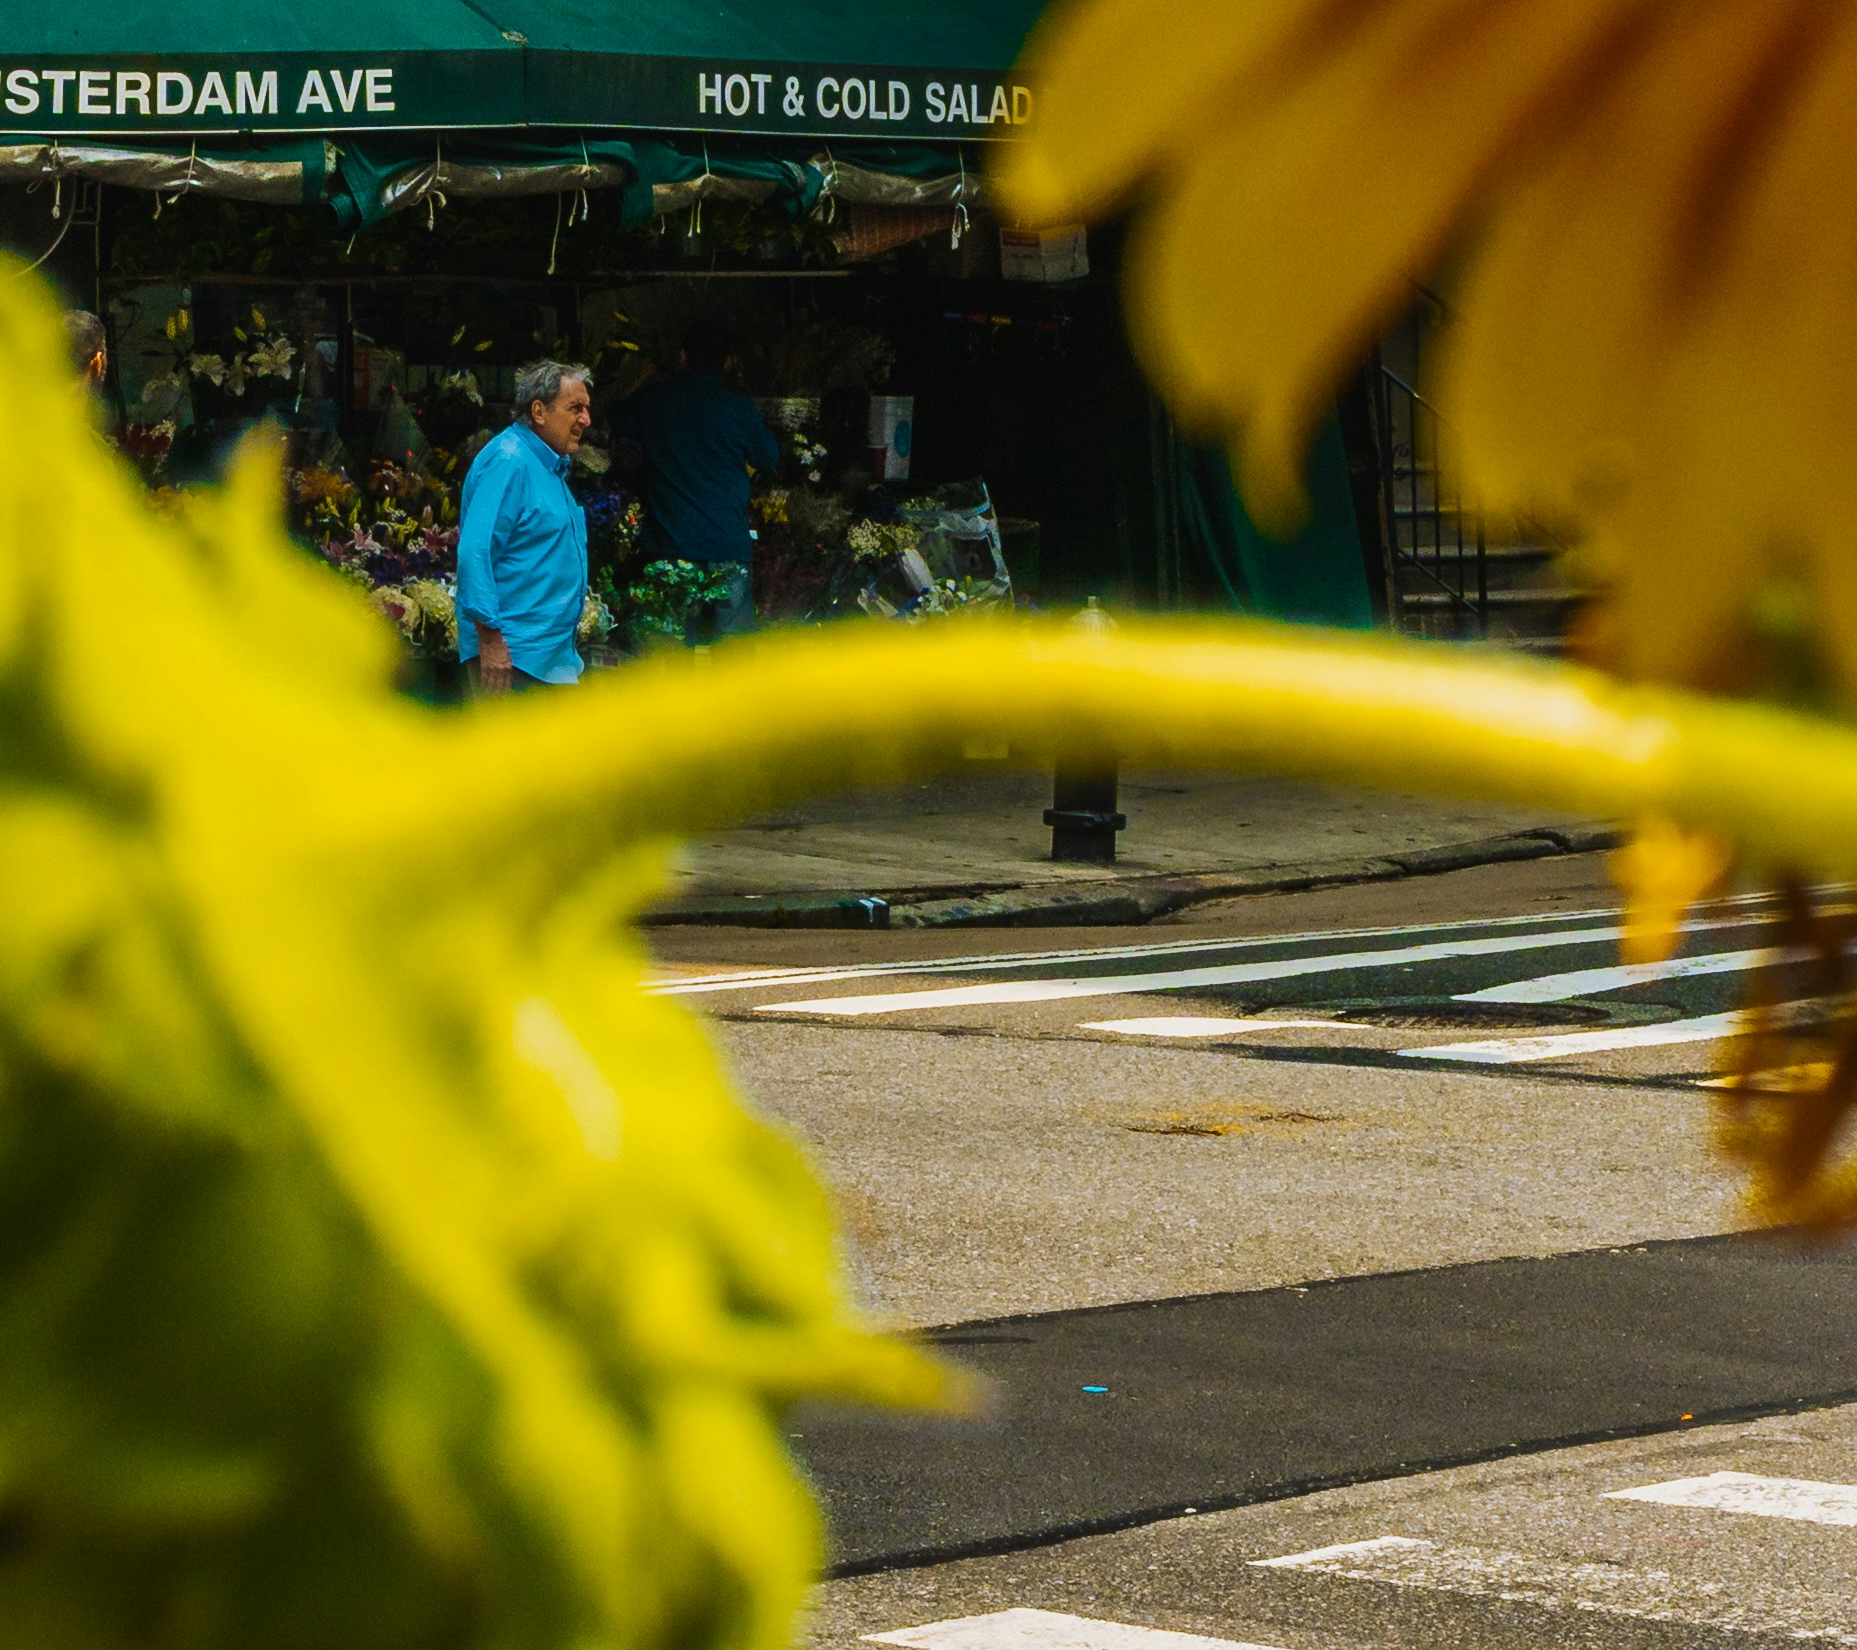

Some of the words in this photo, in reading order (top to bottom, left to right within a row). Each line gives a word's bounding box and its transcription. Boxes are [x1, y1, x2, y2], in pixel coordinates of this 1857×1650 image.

[295, 68, 396, 114] AVE
[699, 73, 772, 116] HOT
[783, 76, 806, 117] &
[817, 76, 910, 121] COLD
[925, 82, 1032, 125] SALAD
